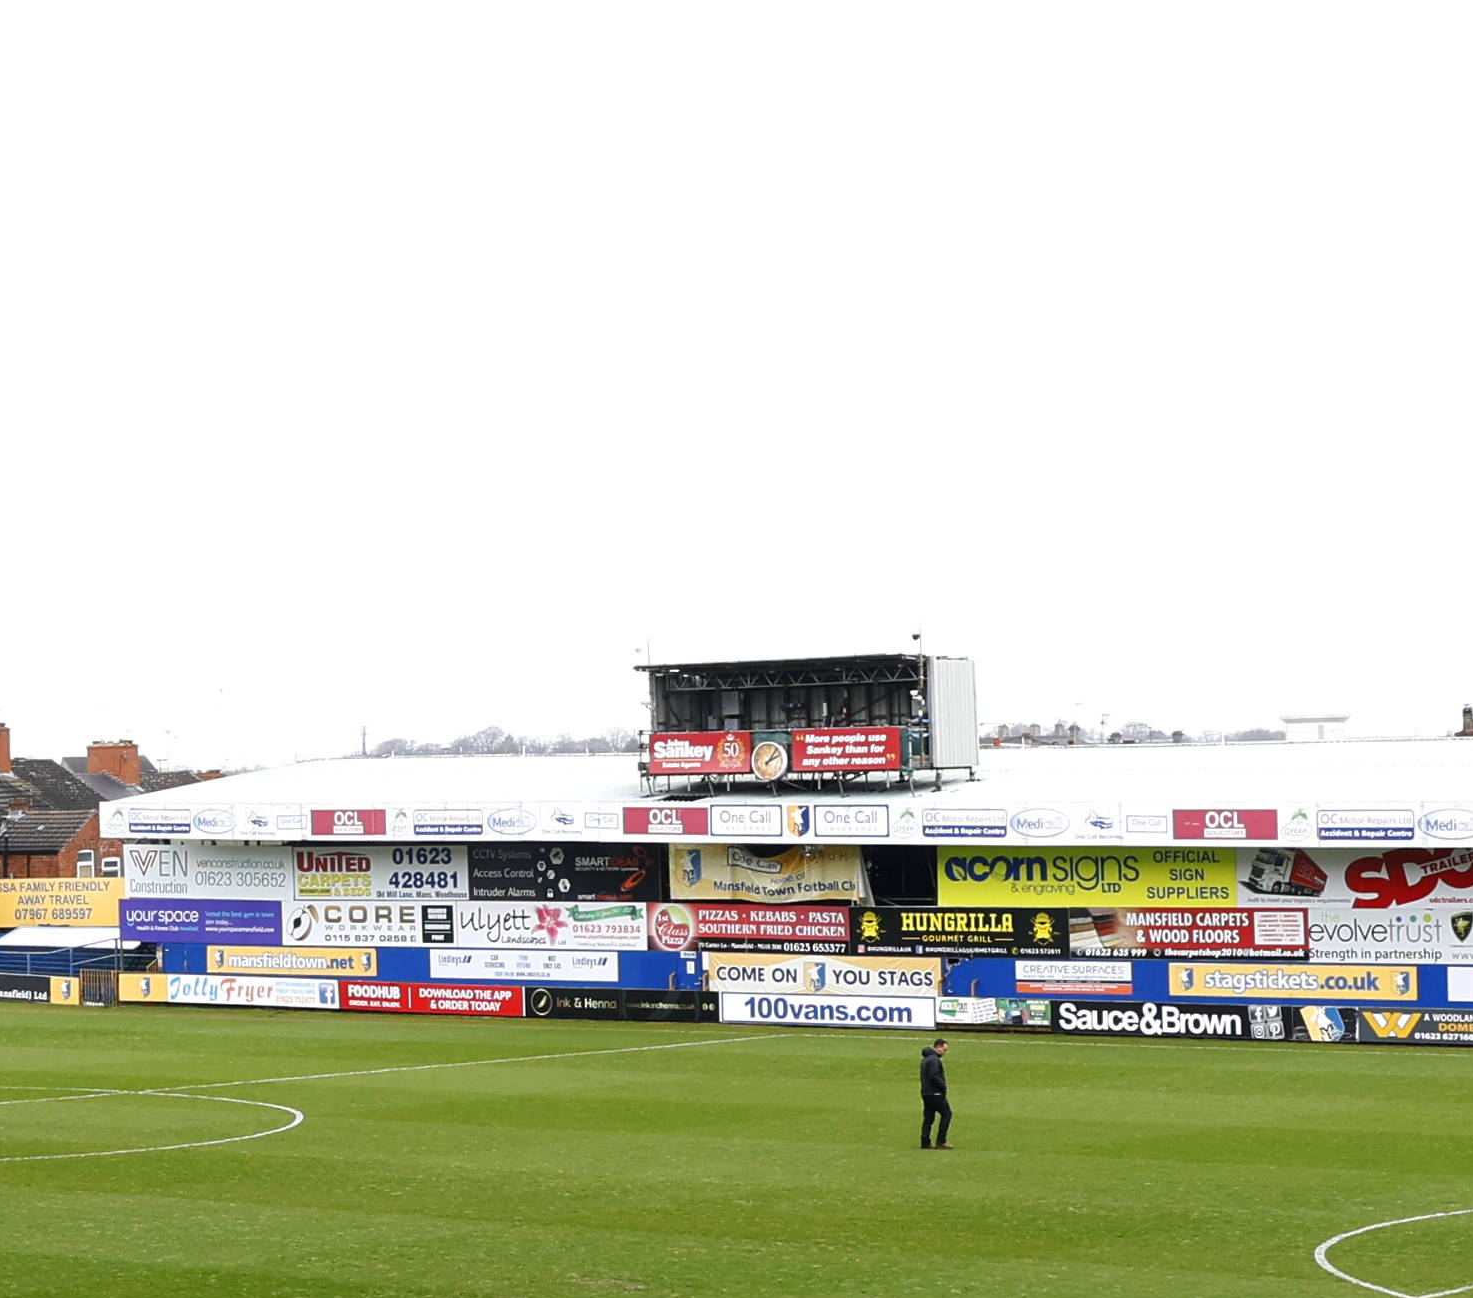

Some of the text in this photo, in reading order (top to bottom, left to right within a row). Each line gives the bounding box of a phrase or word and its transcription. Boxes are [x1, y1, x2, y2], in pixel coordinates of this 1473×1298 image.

[654, 743, 712, 761] Sankey
[130, 850, 187, 876] VEN
[392, 849, 452, 865] 01623
[1154, 850, 1220, 863] OFFICIAL
[944, 855, 1140, 889] acorn signs
[1169, 868, 1204, 881] SIGN
[19, 881, 110, 891] FAMILY FRIENDLY
[298, 874, 371, 887] CARPETS
[390, 872, 458, 889] 428481
[1022, 883, 1076, 895] engraving
[1147, 886, 1230, 899] SUPPLIERS
[49, 895, 89, 905] TRAVEL
[324, 906, 416, 923] CORE
[698, 910, 844, 923] PIZZAS KEBABS PASTA
[1126, 913, 1249, 927] MANSFIELD CARPETS
[901, 913, 1014, 933] HUNGRILLA
[1310, 917, 1441, 943] evolvetrust
[698, 925, 845, 937] SOUTHERN FRIED CHICKEN
[922, 935, 964, 943] GOURMET
[228, 953, 354, 969] mansfieldtown.net
[1375, 949, 1442, 962] partnership
[716, 966, 933, 987] COME ON YOU STAGS
[1204, 969, 1378, 993] stagstickets.co.uk
[348, 985, 473, 1000] FOODHUB DOWNLOAD
[744, 997, 912, 1023] 100vans.com
[1059, 1003, 1242, 1037] Sauce&Brown
